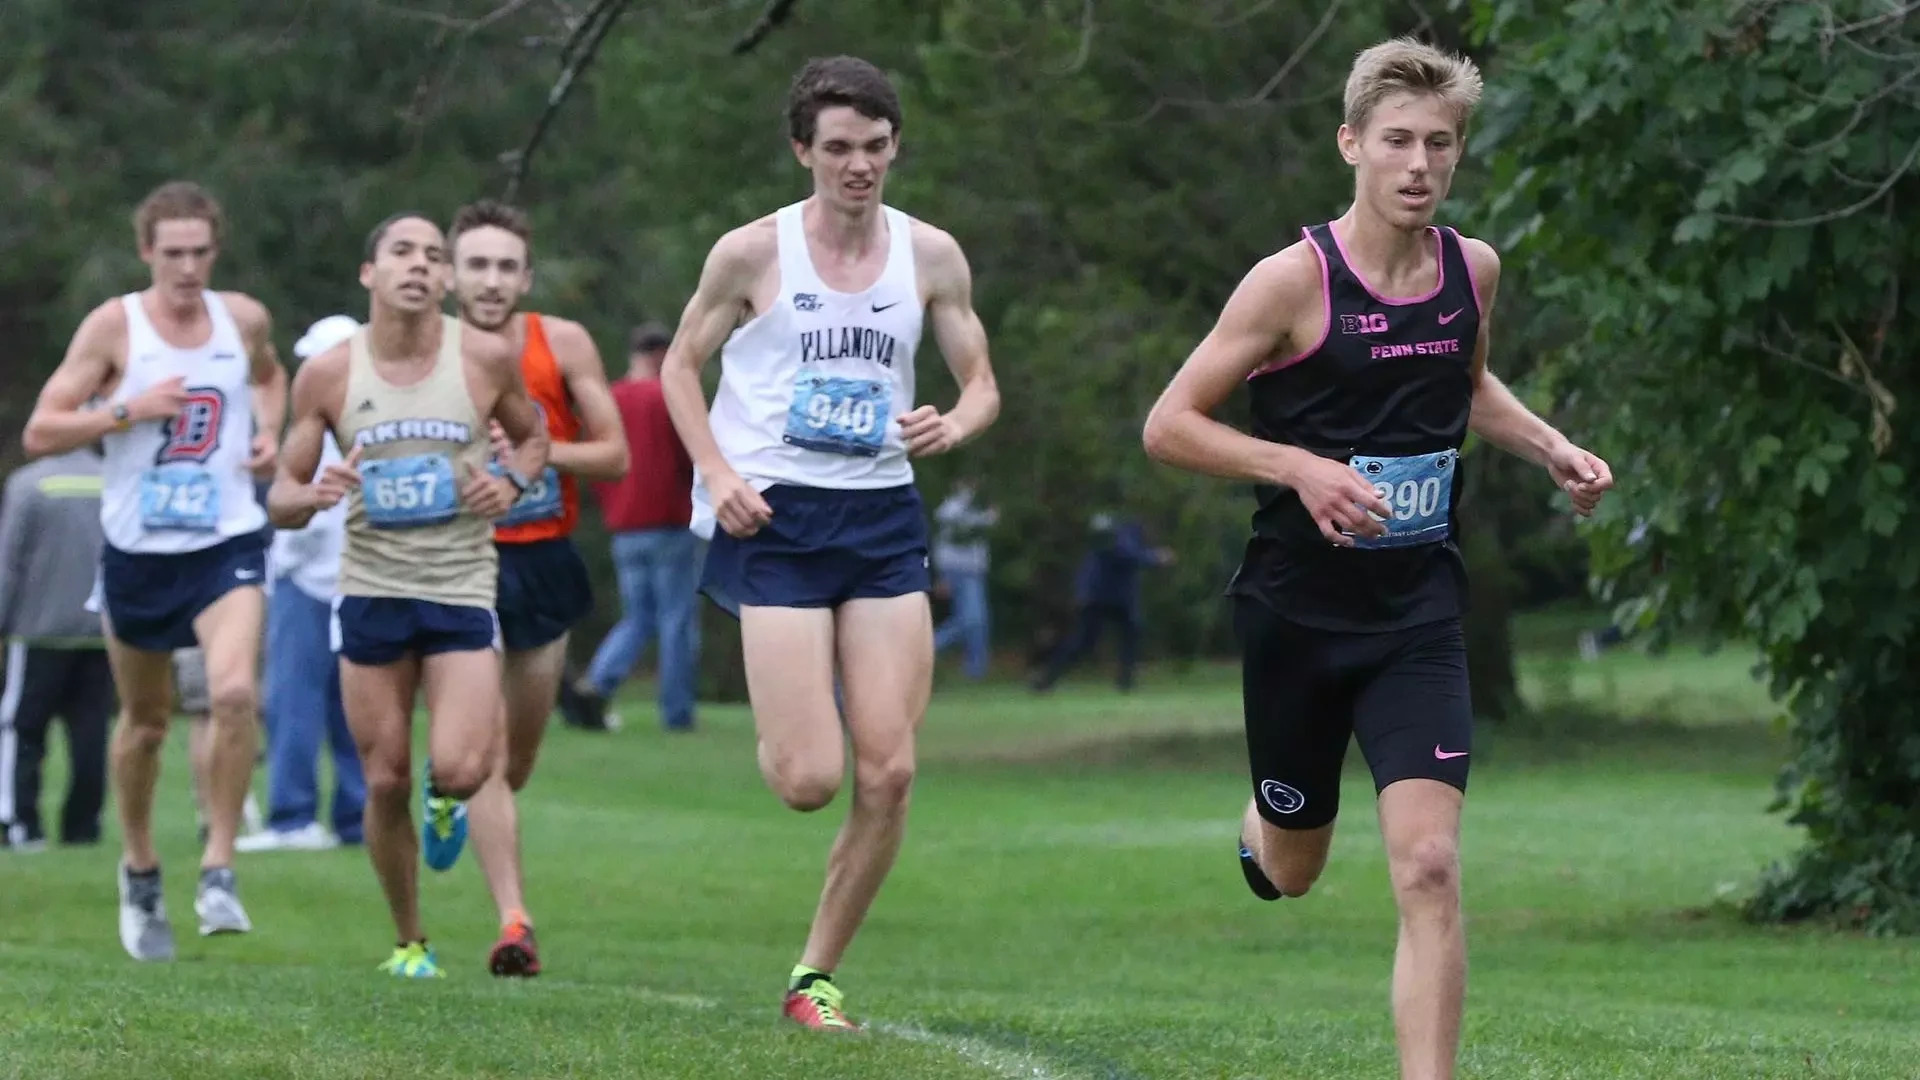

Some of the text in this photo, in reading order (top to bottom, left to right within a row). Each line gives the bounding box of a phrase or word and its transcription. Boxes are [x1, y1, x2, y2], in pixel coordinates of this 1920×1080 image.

[800, 326, 895, 368] VLLANOVA
[1371, 339, 1459, 359] PENN STATE
[155, 386, 227, 466] D
[355, 418, 470, 445] AKRON
[806, 393, 875, 435] 940
[151, 483, 209, 514] 742
[375, 472, 438, 509] 657
